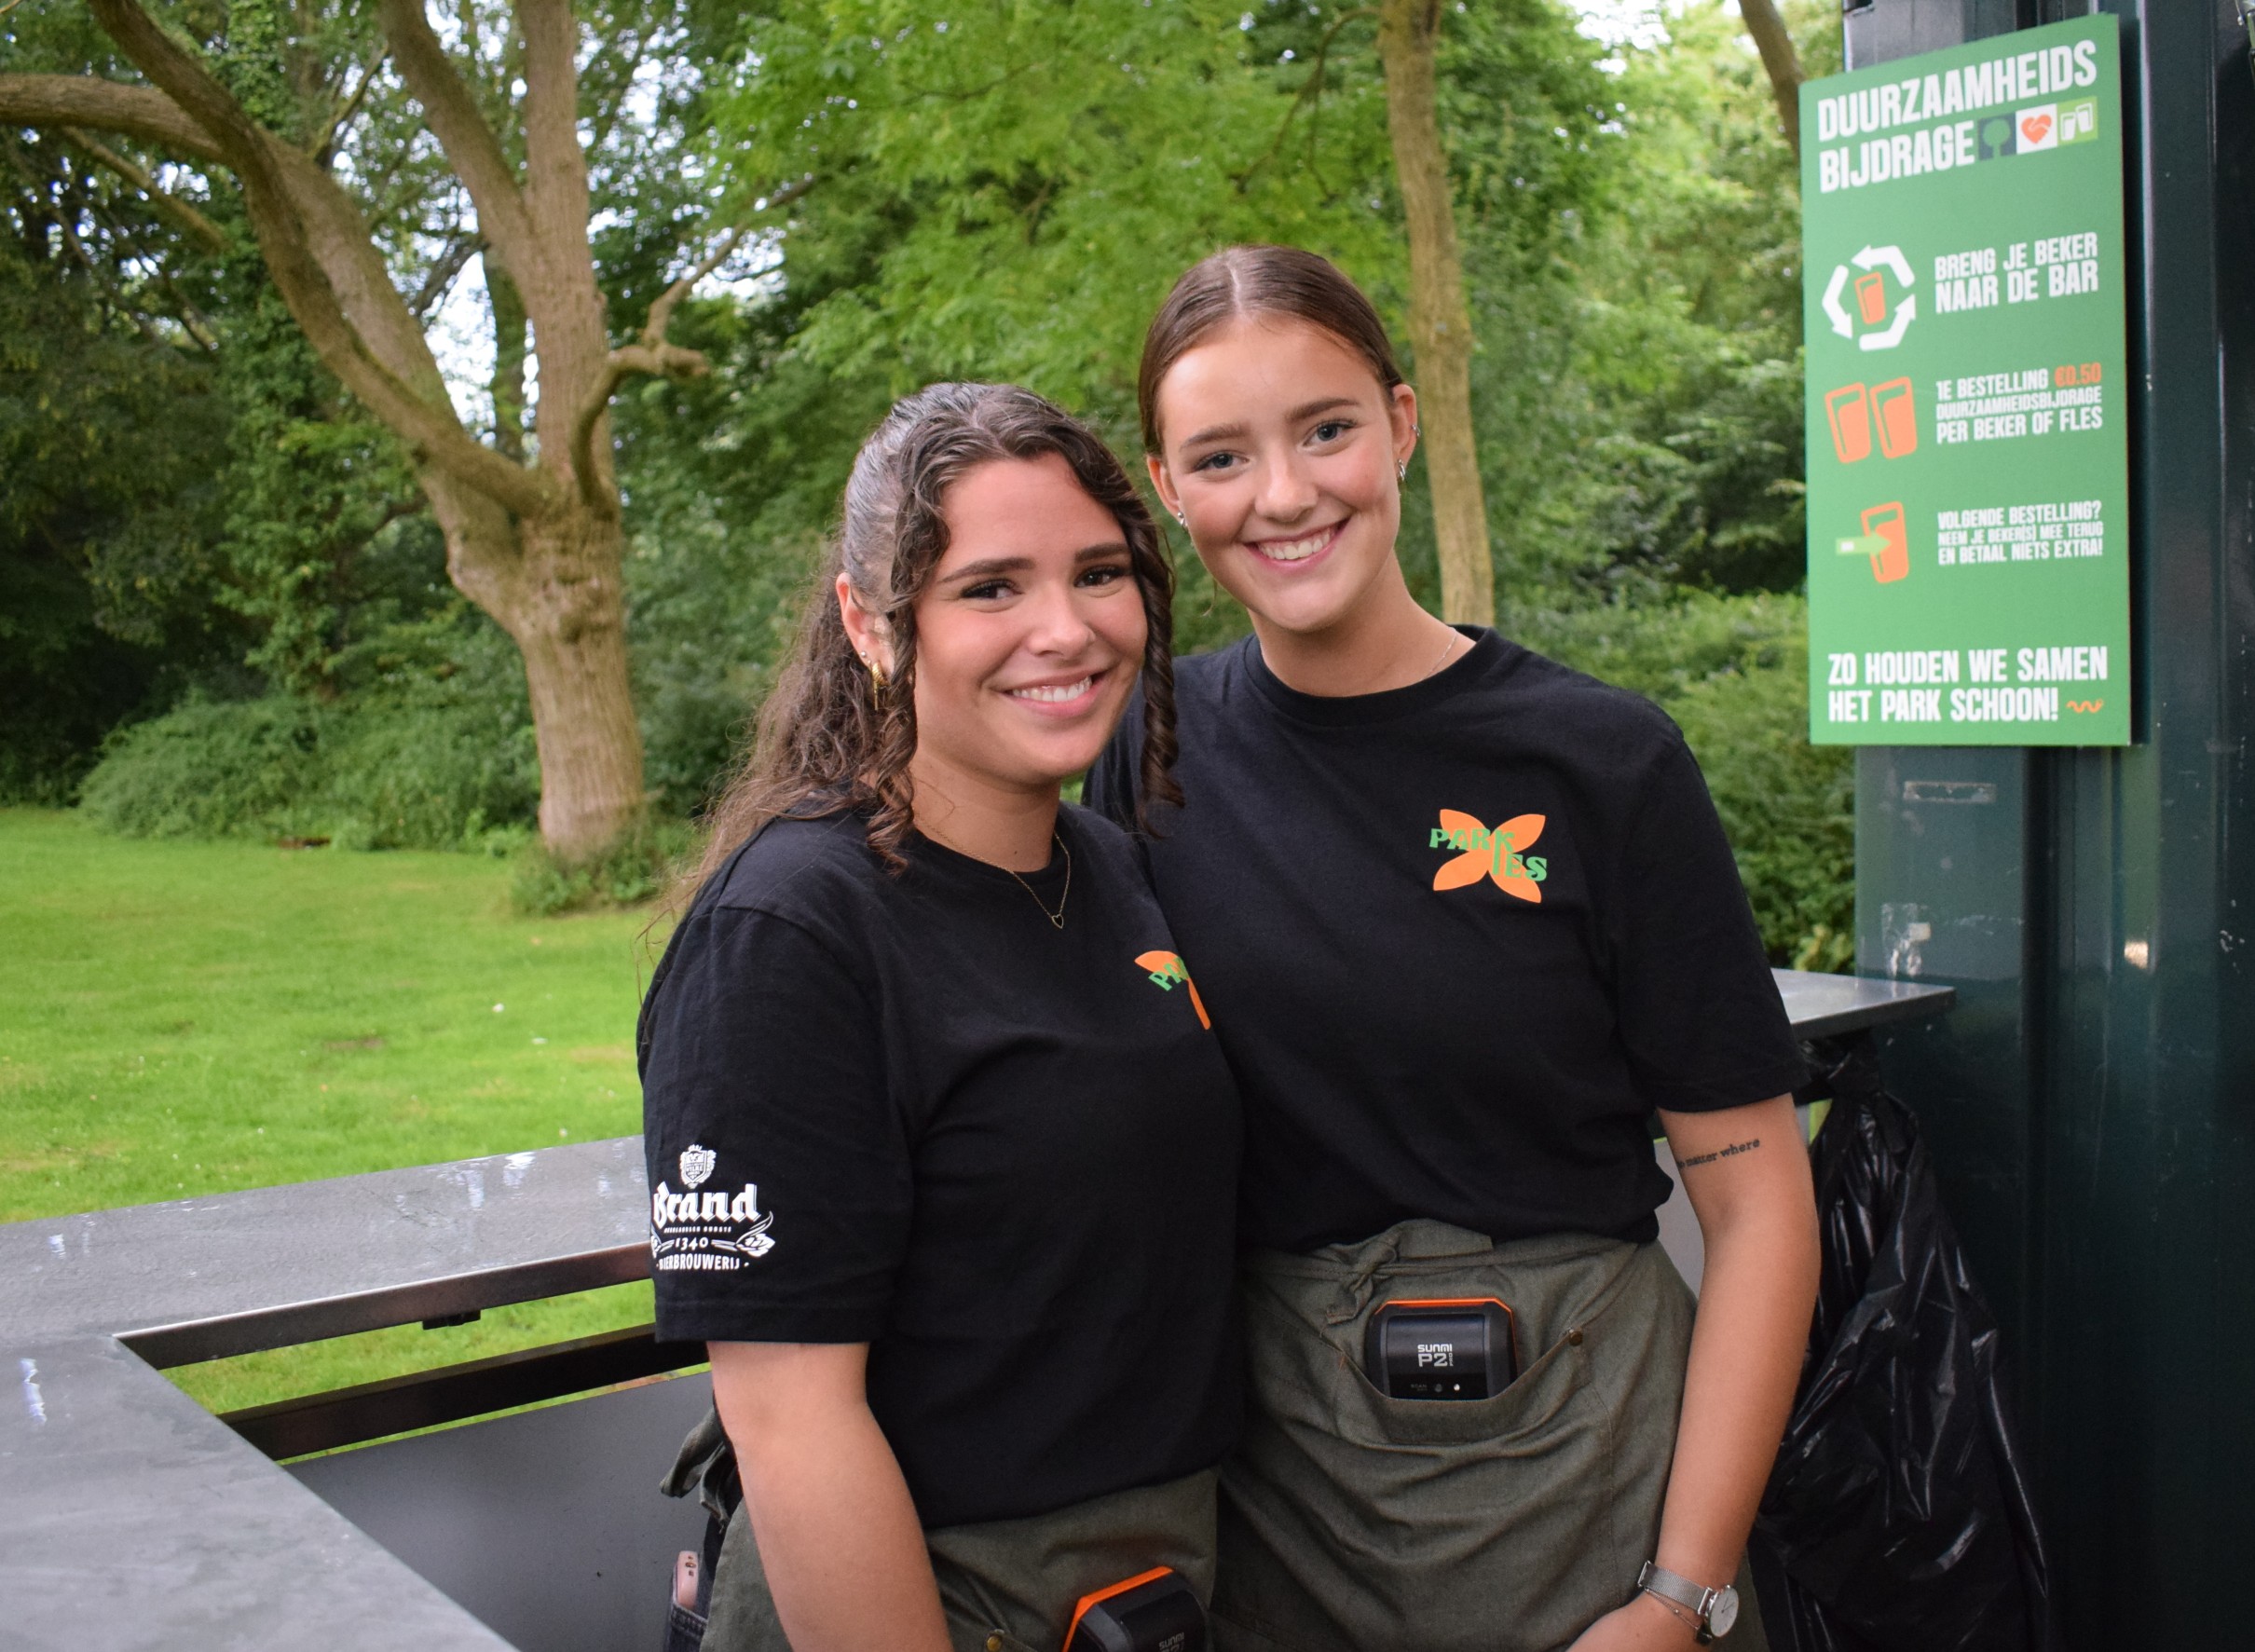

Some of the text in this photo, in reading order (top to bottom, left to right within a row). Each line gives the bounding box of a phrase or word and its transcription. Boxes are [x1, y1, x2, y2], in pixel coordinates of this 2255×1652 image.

[1818, 39, 2097, 142] DUURZAAMHEIDS
[1820, 120, 1975, 193] BIJDRAGE
[1934, 231, 2098, 281] BRENG JE BEKER
[1935, 259, 2098, 314] NAAR DE BAR
[1935, 380, 1952, 401] 1E
[1957, 368, 2049, 399] BESTELLING
[1936, 386, 2102, 420] DUURZAAMHEIDSBIJDRAGE
[1936, 405, 2102, 444] PER BEKER OF FLES
[1937, 499, 2102, 530] VOLGENDE BESTELLING?
[1937, 530, 1968, 546] NEEM
[1970, 528, 1985, 544] JE
[2040, 523, 2063, 539] MEE
[2067, 521, 2103, 538] TERUG
[1938, 538, 2103, 566] EN BETAAL NIETS EXTRA!
[1827, 646, 2108, 686] ZO HOUDEN WE SAMEN
[1827, 687, 2058, 722] HET PARK SCHOON!
[1720, 1139, 1760, 1157] where
[653, 1181, 761, 1230] Brand
[675, 1236, 709, 1250] 1340
[1417, 1353, 1448, 1367] P2
